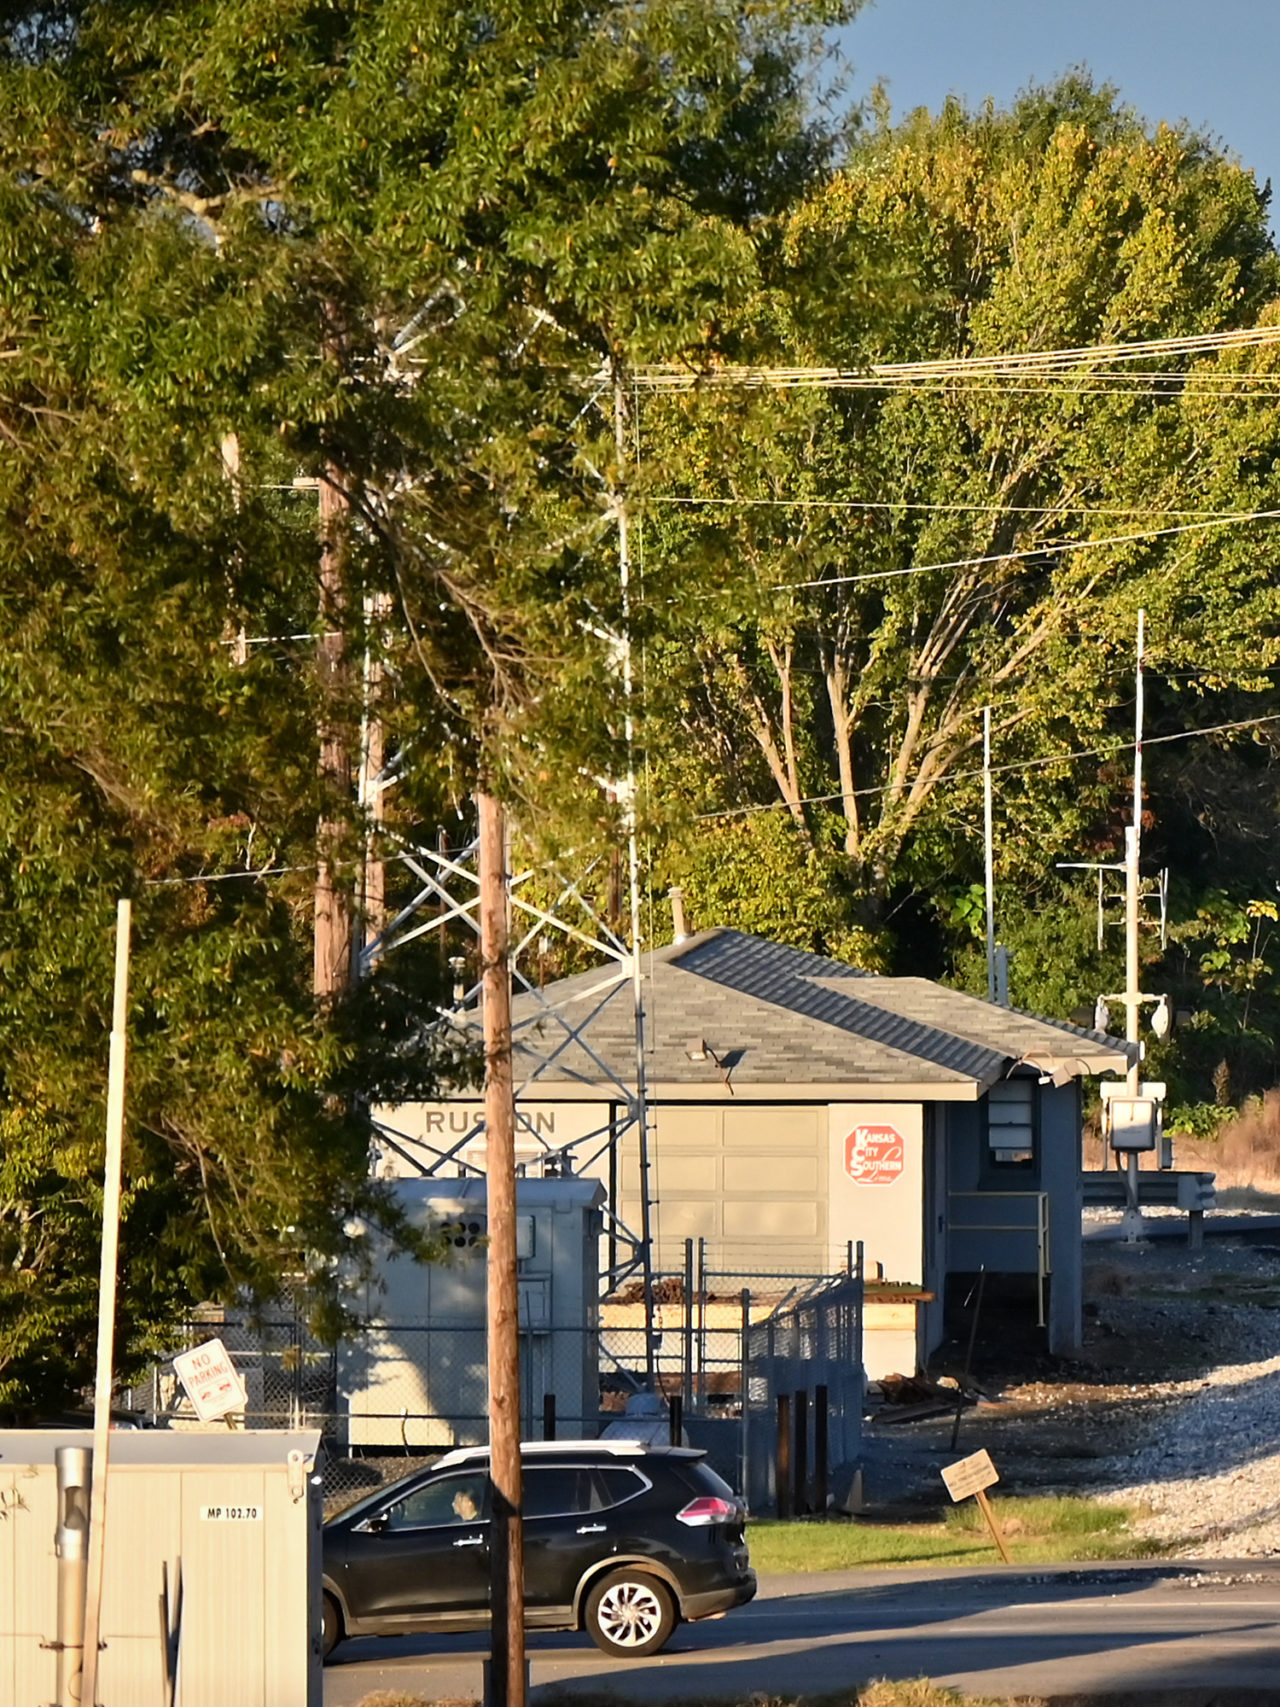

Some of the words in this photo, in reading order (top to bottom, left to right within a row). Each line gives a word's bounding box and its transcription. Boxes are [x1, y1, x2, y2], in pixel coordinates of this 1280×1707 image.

[426, 1111, 555, 1133] RUSON
[191, 1353, 211, 1370] NO
[188, 1362, 229, 1388] PARKING
[207, 1507, 222, 1519] MP
[226, 1507, 257, 1519] 102.70
